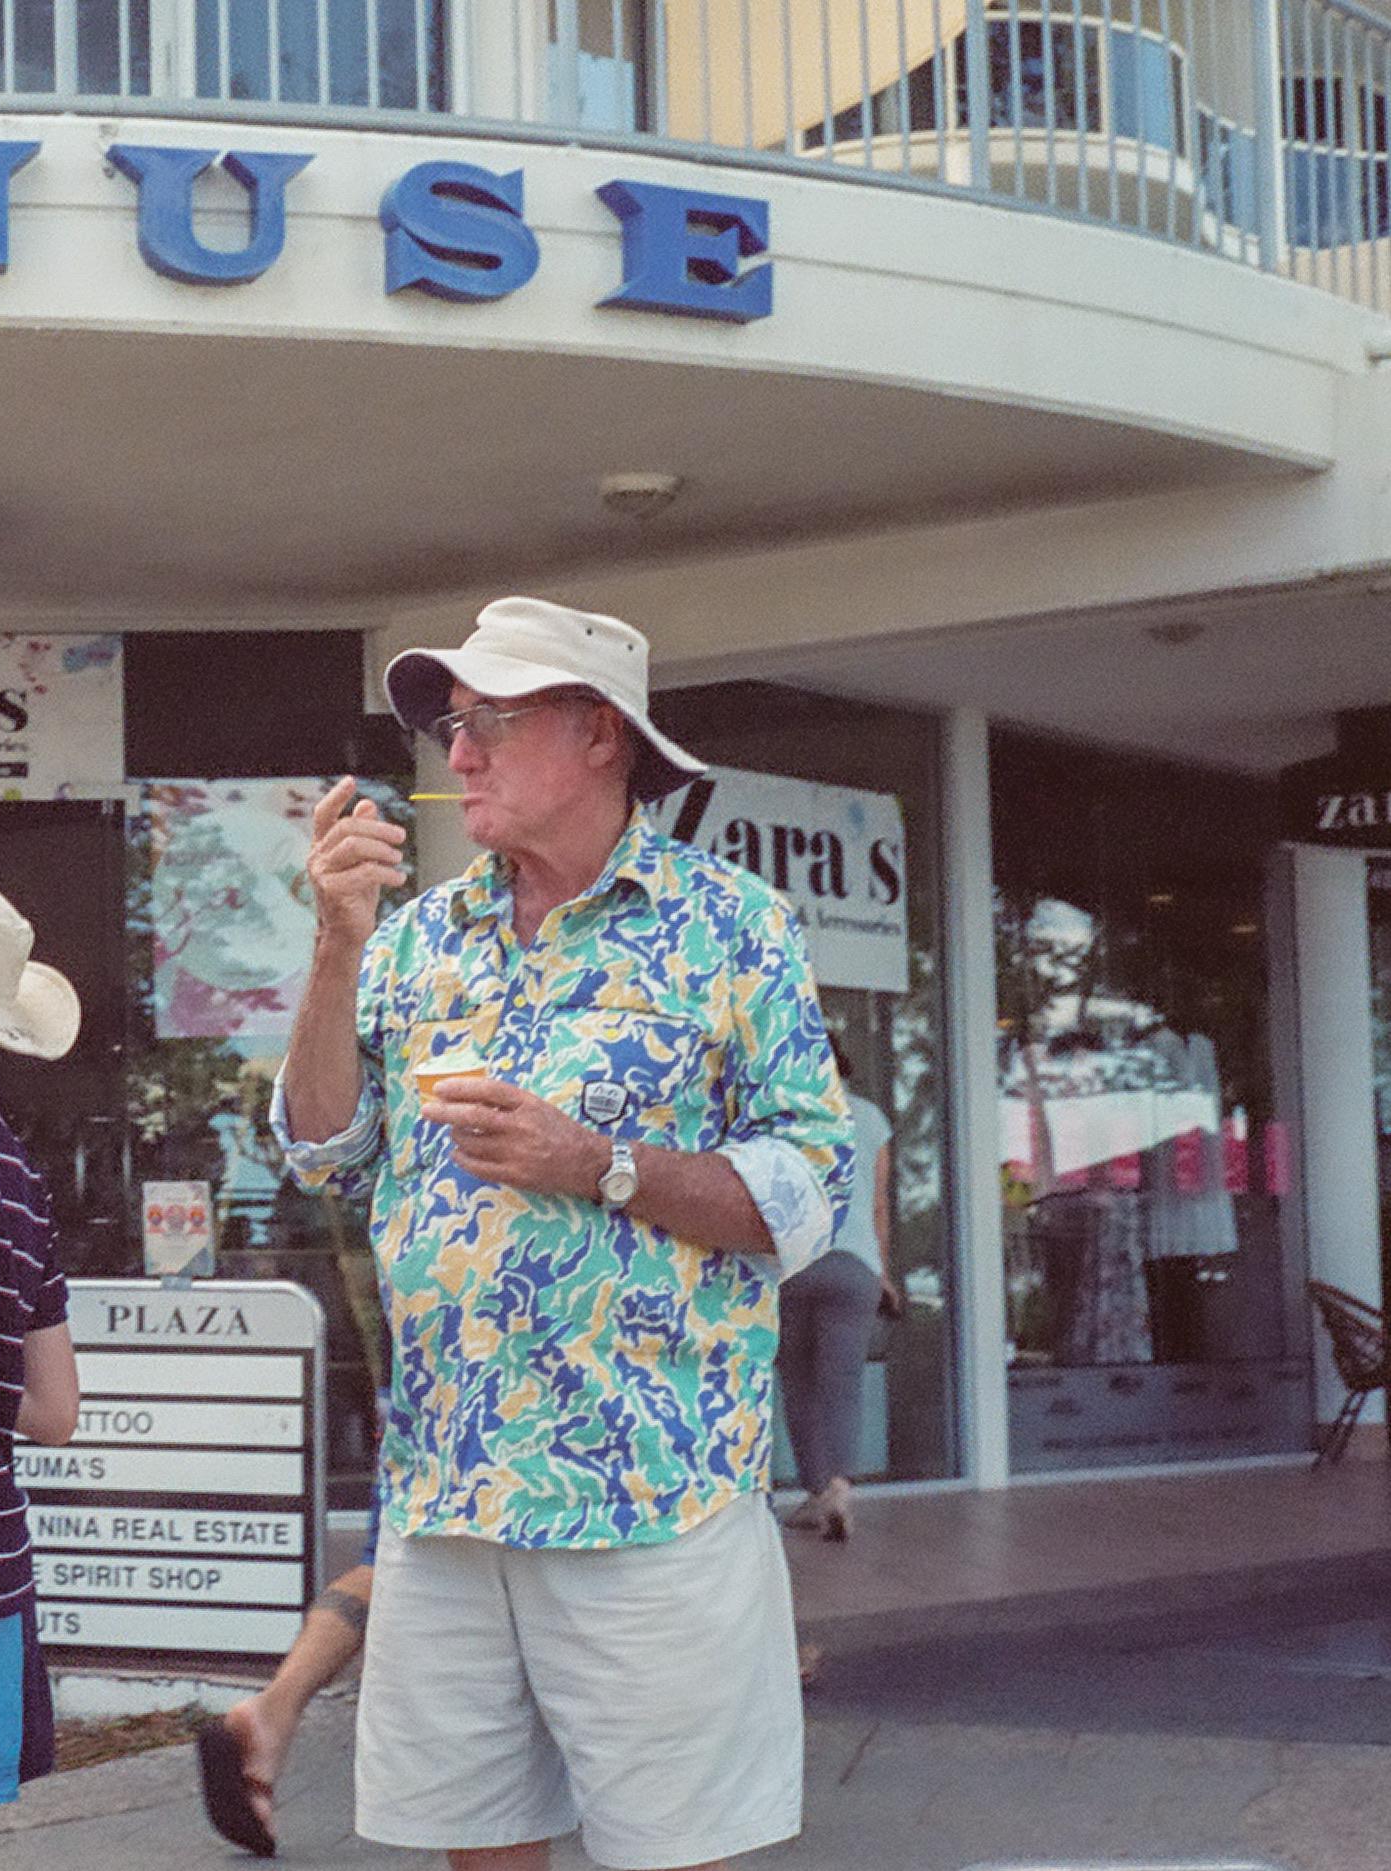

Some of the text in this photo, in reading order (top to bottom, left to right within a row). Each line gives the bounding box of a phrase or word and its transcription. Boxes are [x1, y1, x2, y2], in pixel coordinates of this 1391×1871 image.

[107, 1304, 250, 1335] PLAZA
[78, 1410, 154, 1434] TTOO
[37, 1516, 289, 1545] NINA REAL ESTATE
[53, 1563, 137, 1588] SPIRIT
[149, 1566, 221, 1591] SHOP
